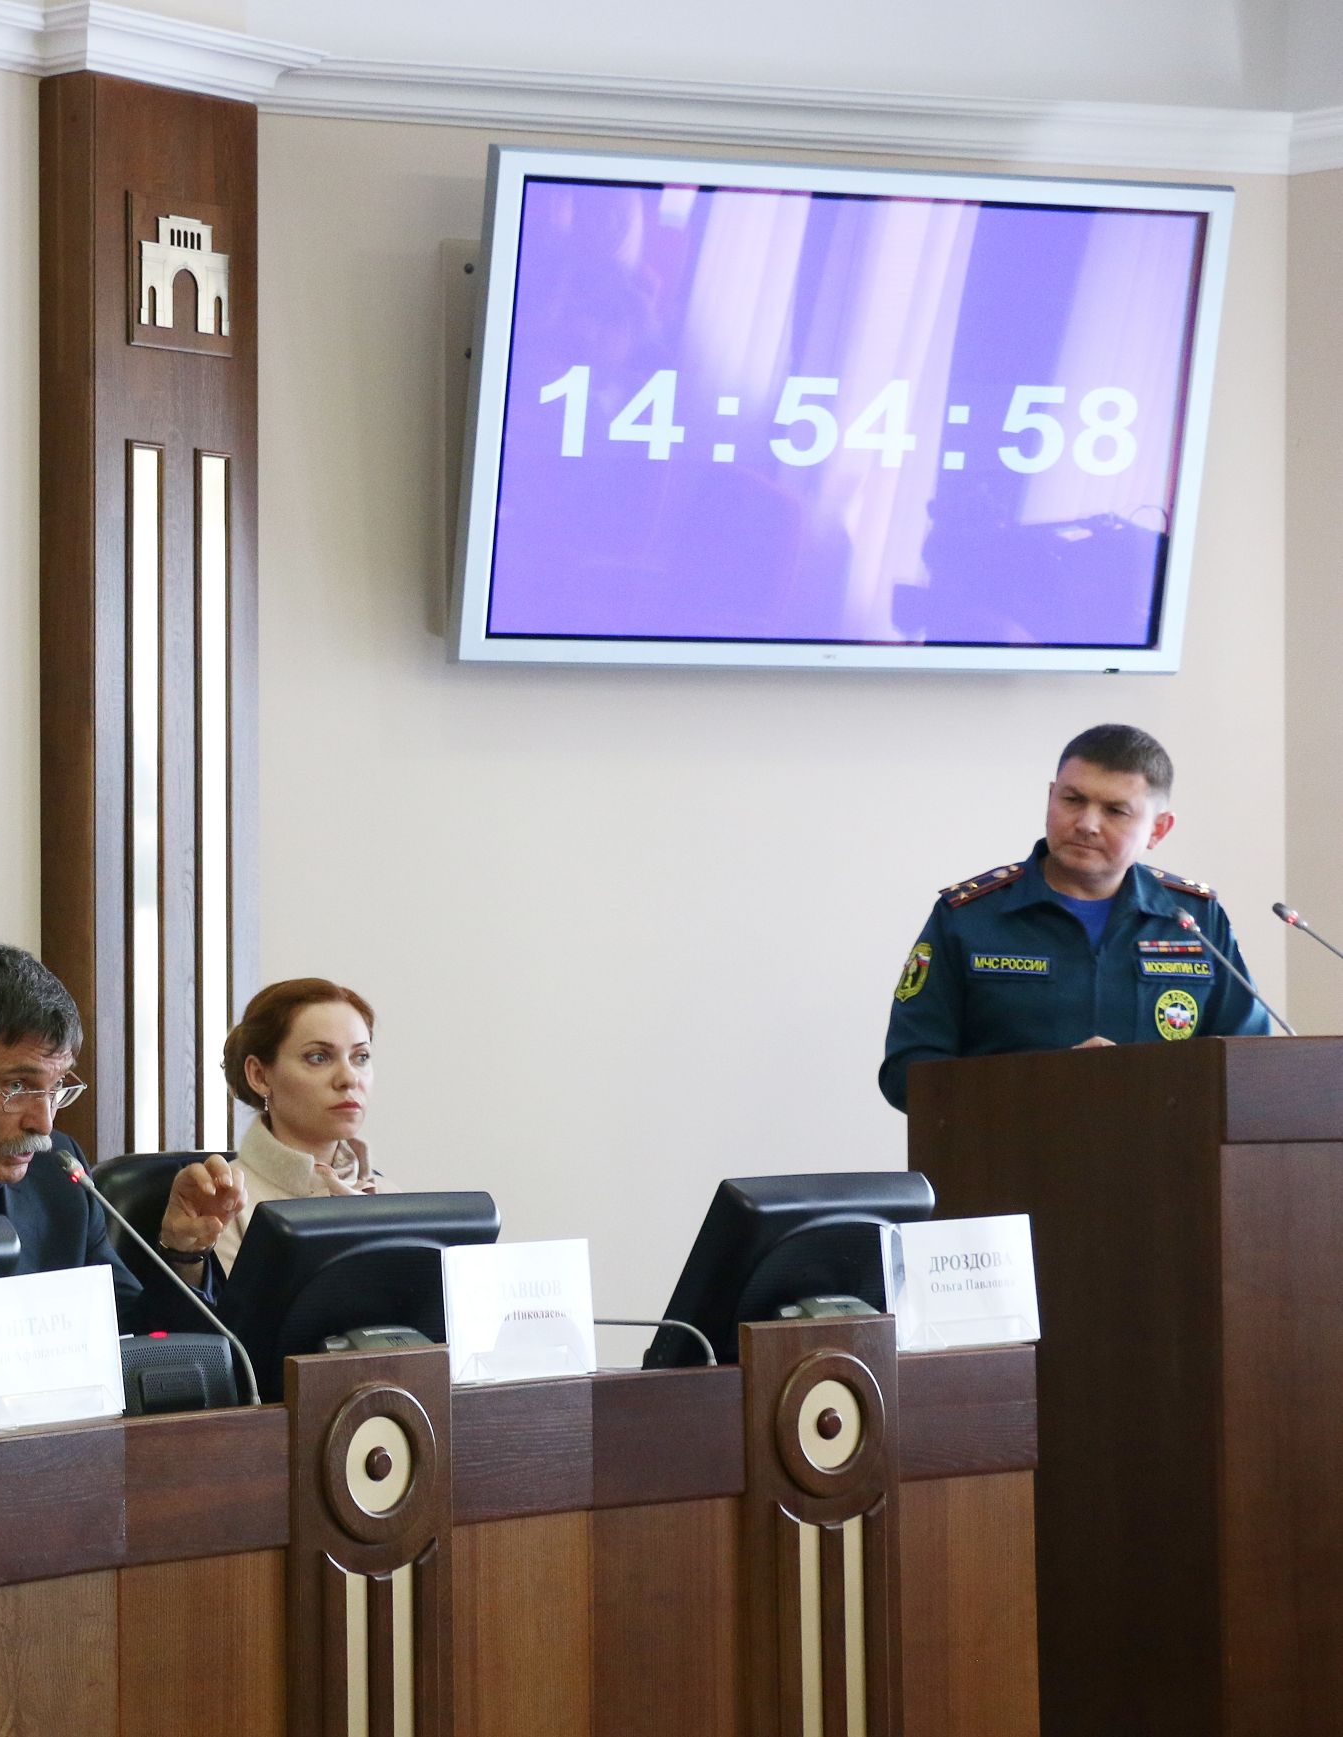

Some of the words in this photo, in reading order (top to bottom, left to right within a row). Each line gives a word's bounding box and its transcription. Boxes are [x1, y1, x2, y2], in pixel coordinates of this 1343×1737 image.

[974, 956, 999, 969] МЧС
[1000, 958, 1047, 972] РОССИИ
[931, 1281, 963, 1293] Ольга
